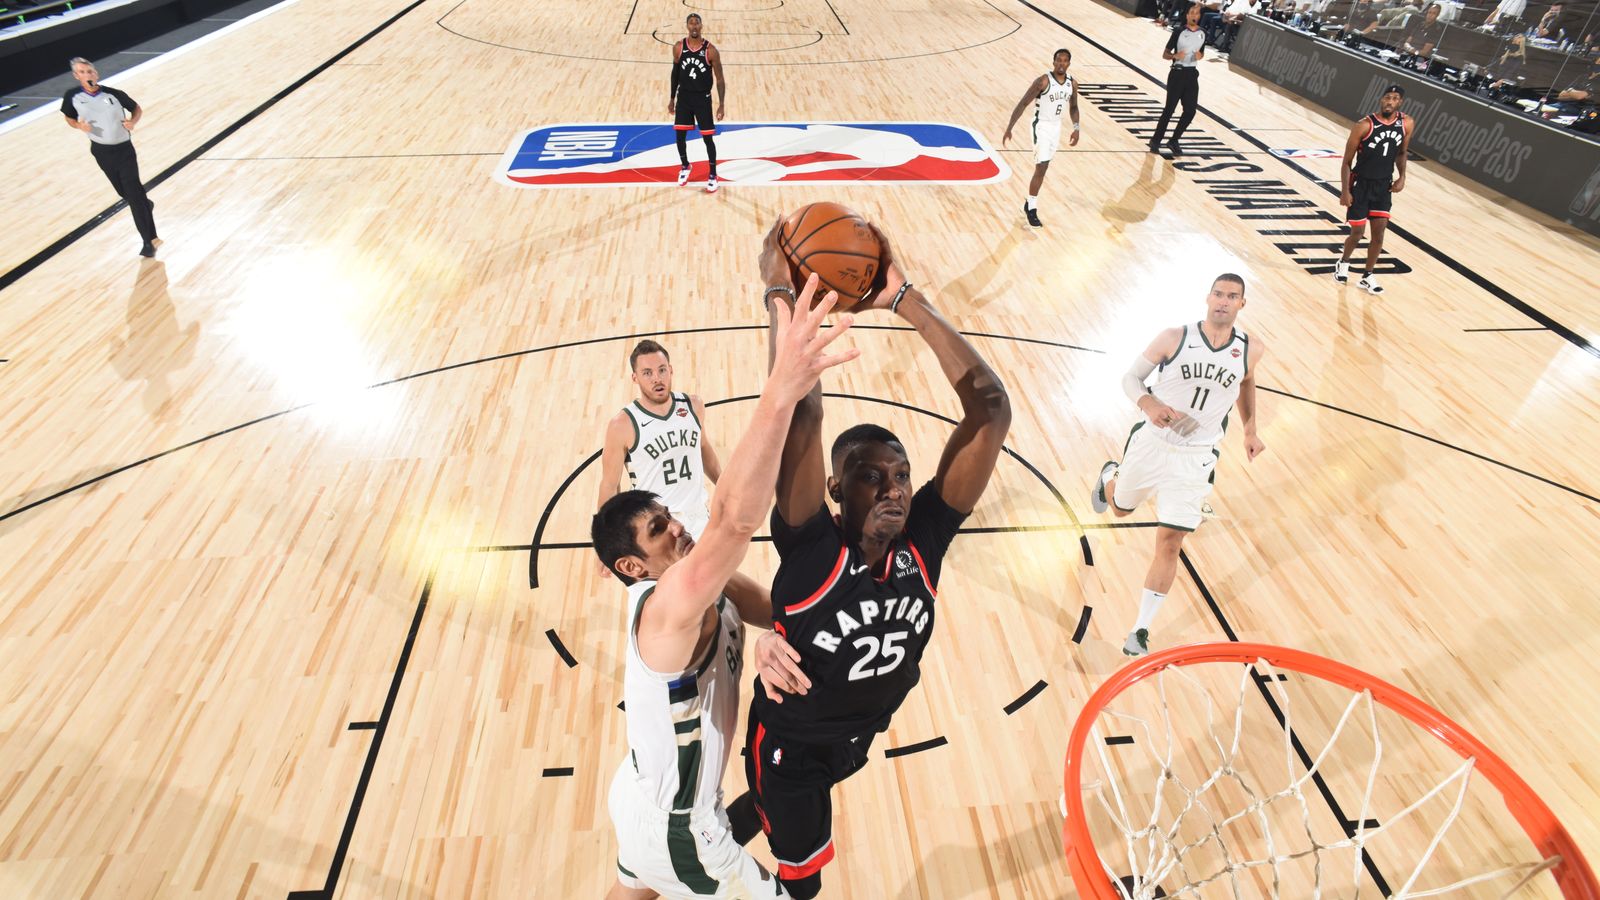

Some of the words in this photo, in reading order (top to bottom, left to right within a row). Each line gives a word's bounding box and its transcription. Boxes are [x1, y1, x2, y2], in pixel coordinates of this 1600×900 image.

[688, 67, 697, 80] 4
[1263, 35, 1309, 84] League
[1299, 50, 1338, 97] Pass
[1049, 91, 1071, 102] BUCKS
[1055, 104, 1063, 116] 6
[1077, 83, 1183, 123] BLACK
[537, 130, 620, 162] NBA
[1125, 127, 1264, 172] LIVES
[1382, 141, 1390, 157] 1
[1181, 362, 1237, 388] BUCKS
[1190, 386, 1210, 411] 11
[643, 429, 698, 460] BUCKS
[662, 455, 692, 485] 24
[812, 596, 929, 654] RAPTORS
[848, 631, 908, 682] 25
